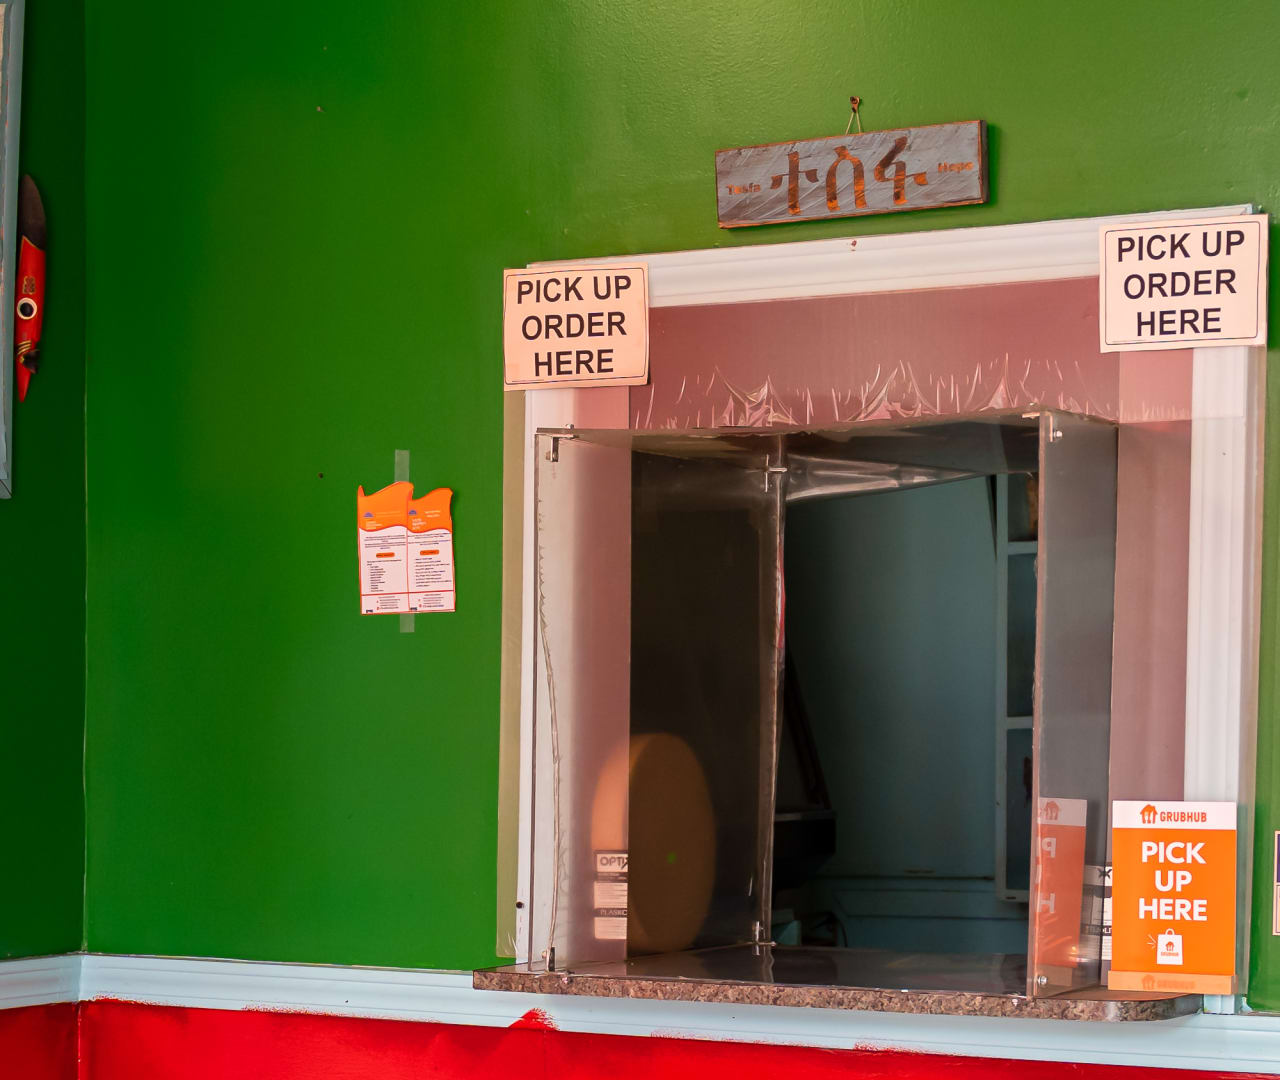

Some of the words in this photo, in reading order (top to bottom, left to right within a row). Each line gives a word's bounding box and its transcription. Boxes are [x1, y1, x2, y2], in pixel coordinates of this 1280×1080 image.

[770, 136, 928, 215] ተስፋ
[1118, 233, 1191, 262] PICK
[1203, 230, 1245, 256] UP
[517, 277, 584, 304] PICK
[594, 275, 631, 300] UP
[1124, 269, 1236, 299] ORDER
[522, 311, 627, 340] ORDER
[1137, 308, 1222, 336] HERE
[535, 349, 614, 376] HERE
[1160, 811, 1208, 823] GRUBHUB
[1141, 841, 1207, 864] PICK
[1155, 870, 1192, 893] UP
[1138, 898, 1208, 921] HERE
